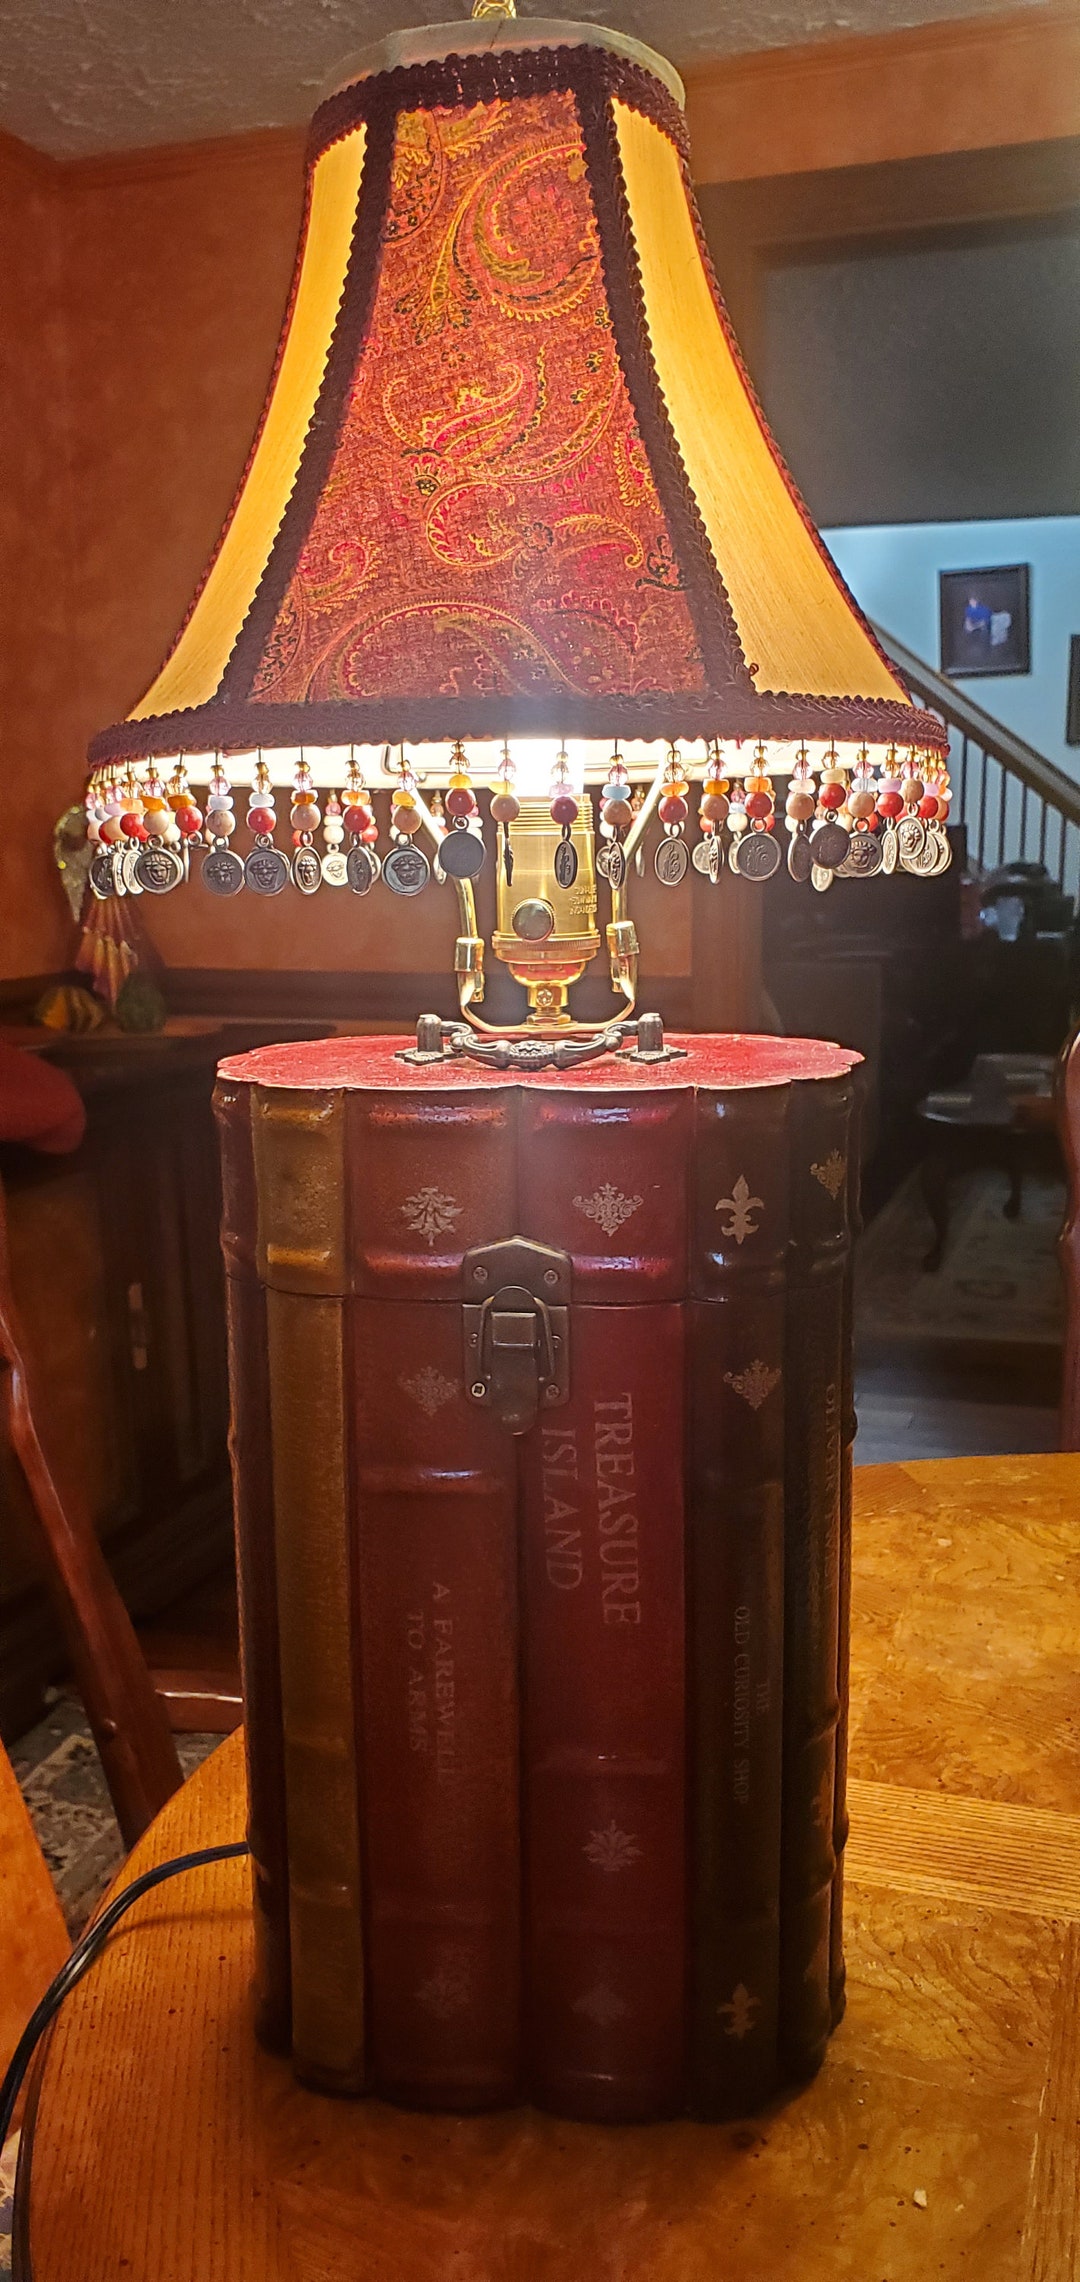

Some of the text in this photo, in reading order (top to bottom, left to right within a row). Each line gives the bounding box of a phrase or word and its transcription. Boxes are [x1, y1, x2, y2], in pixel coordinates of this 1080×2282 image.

[541, 1427, 583, 1590] ISLAND
[594, 1392, 640, 1625] TREASURE
[407, 1609, 428, 1752] TO ARMS
[432, 1581, 456, 1786] A FAREWELL
[733, 1606, 750, 1804] OLD CURIOSITY SHOP
